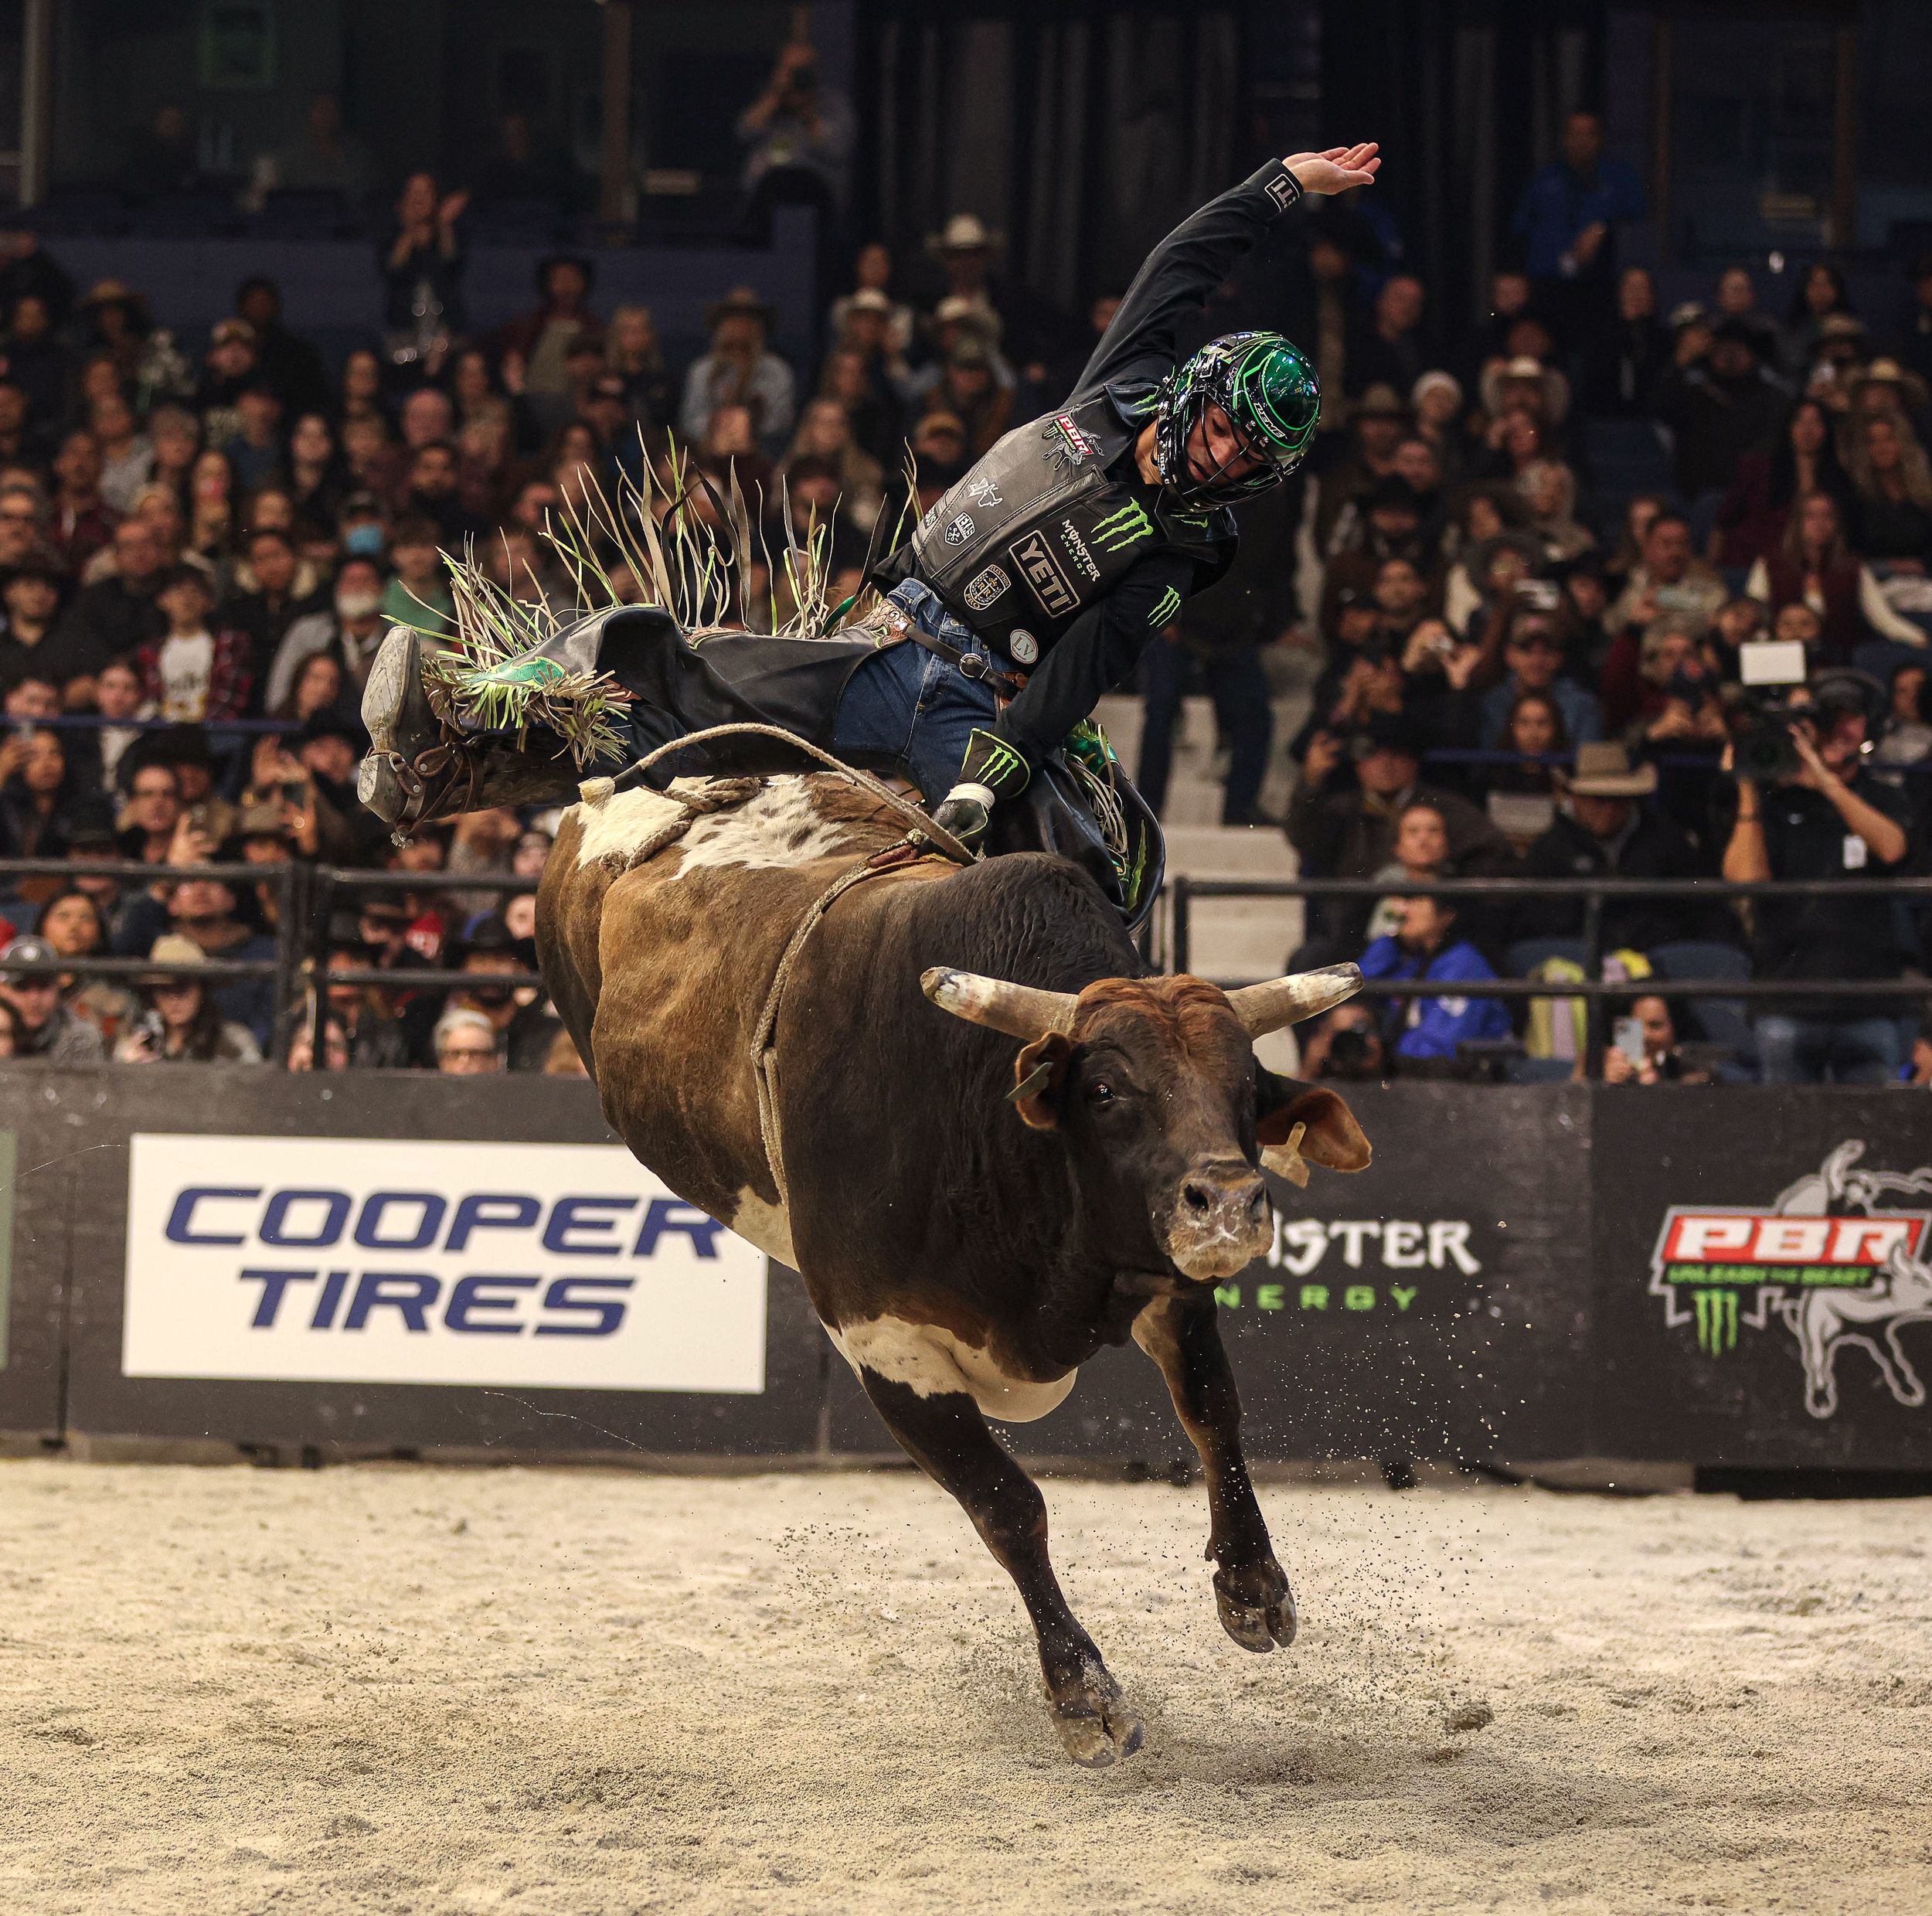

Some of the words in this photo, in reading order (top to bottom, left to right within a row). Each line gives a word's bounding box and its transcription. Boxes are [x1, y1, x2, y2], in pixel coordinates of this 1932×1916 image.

[1059, 416, 1090, 452] PBR
[1253, 402, 1286, 438] LEME
[958, 514, 975, 536] TEXAS
[1060, 533, 1087, 575] ENERGY
[1062, 519, 1100, 582] MONSTER
[1020, 537, 1070, 609] YETI
[965, 593, 981, 609] PRO
[1012, 636, 1034, 656] LV
[164, 1186, 726, 1260] COOPER
[1266, 1208, 1483, 1276] STER
[1675, 1218, 1909, 1264] PBR
[238, 1268, 637, 1338] TIRES
[1213, 1284, 1418, 1312] NERGY
